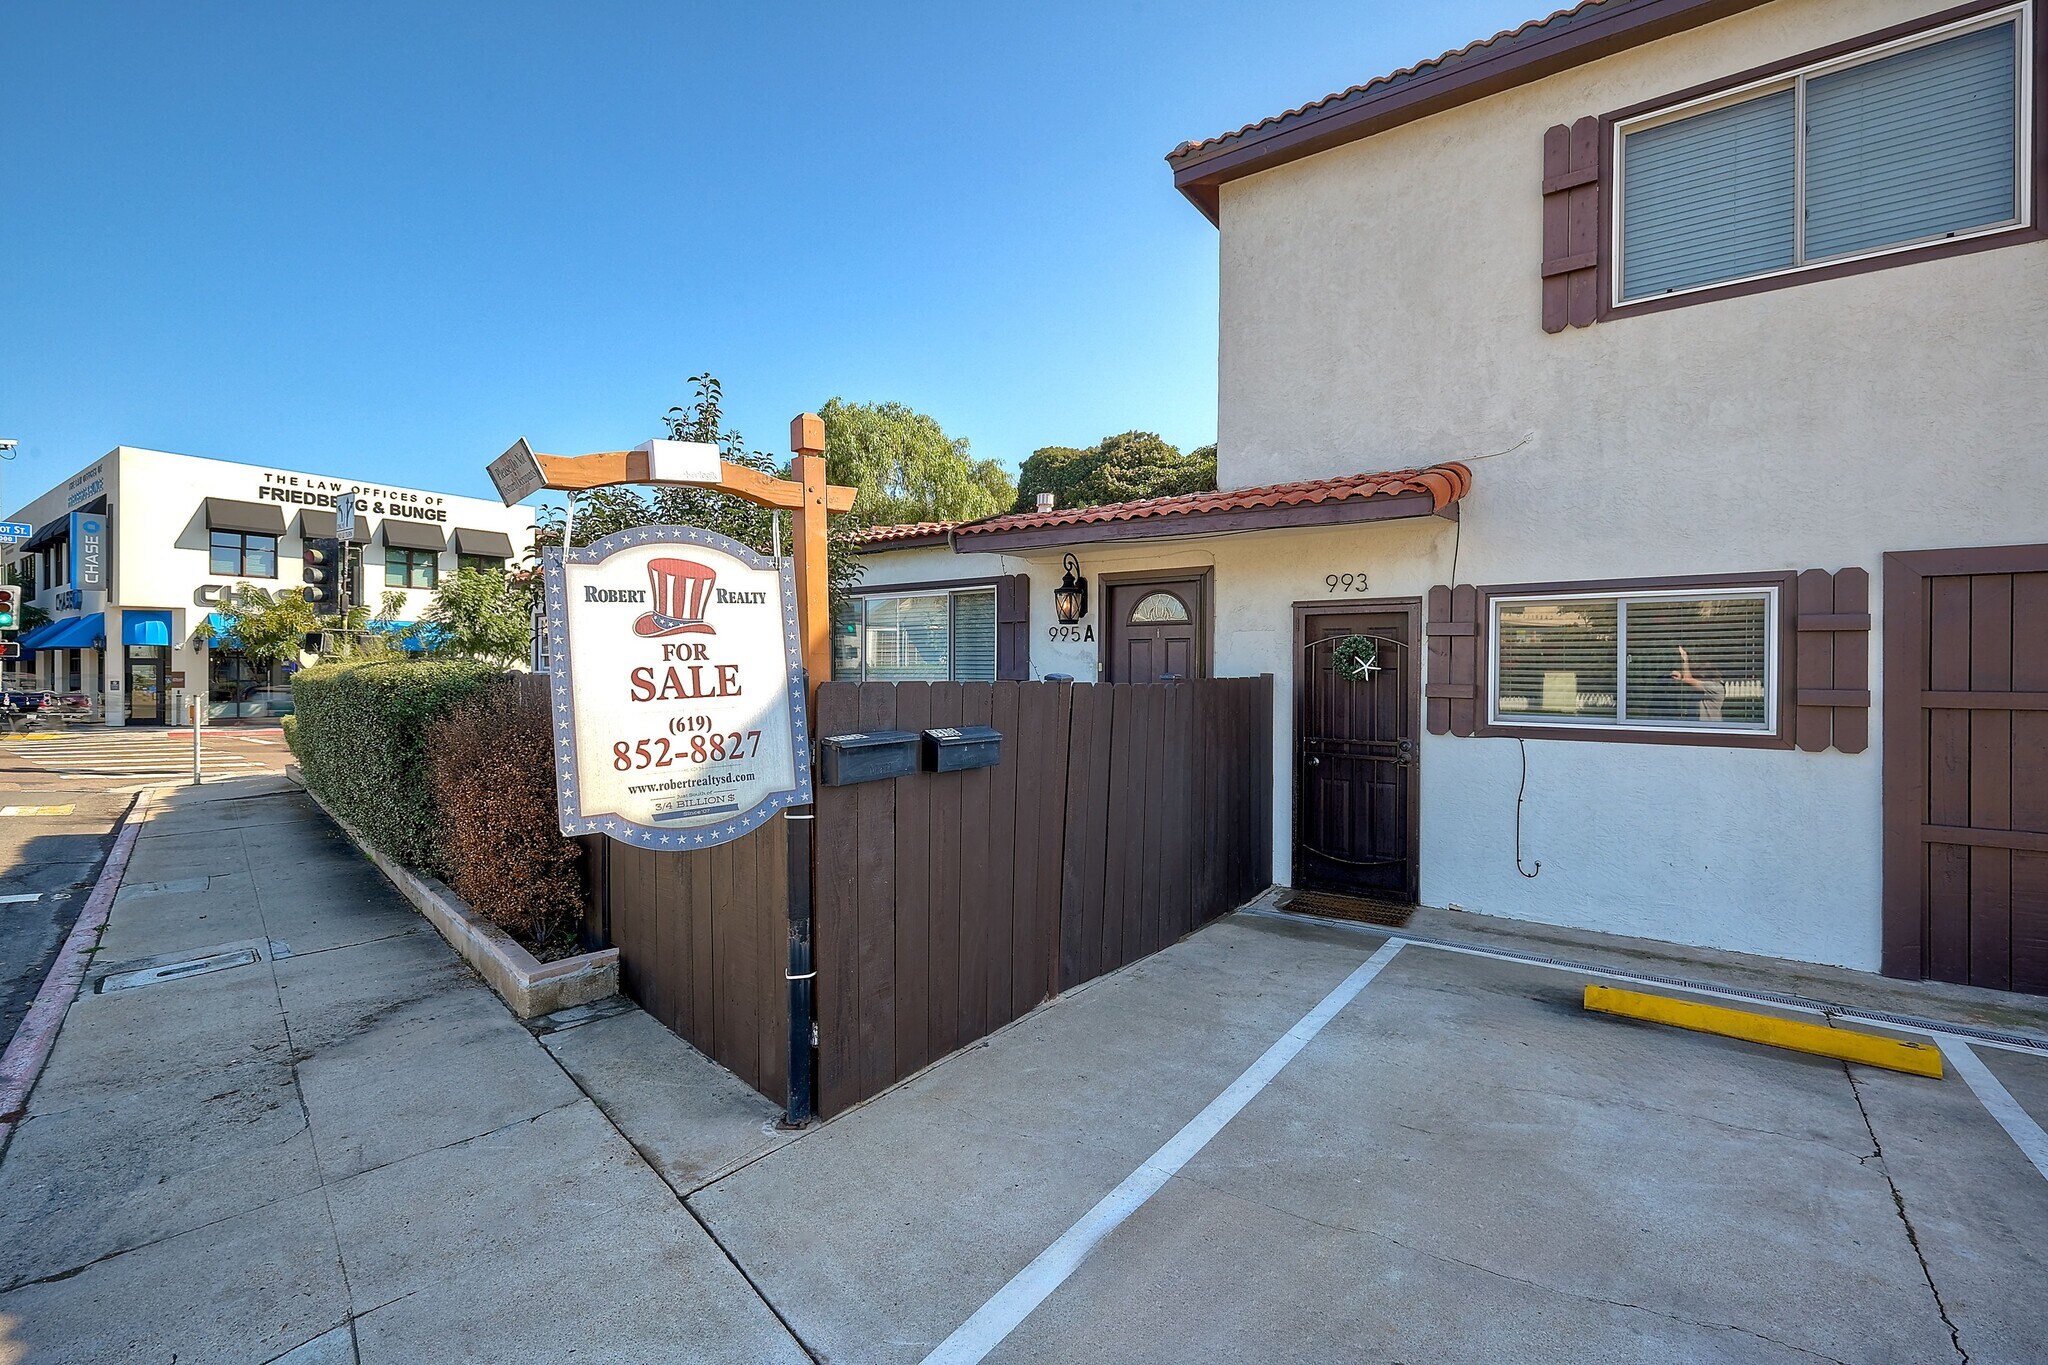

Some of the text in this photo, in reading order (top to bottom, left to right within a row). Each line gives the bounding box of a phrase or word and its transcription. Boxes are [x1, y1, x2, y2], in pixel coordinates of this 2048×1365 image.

[264, 473, 444, 506] THE LAW OFFICES OF
[258, 485, 447, 522] FRIEDBEG & BUNGE
[84, 535, 99, 584] CHASE
[584, 585, 766, 605] ROBERT REALTY
[1325, 572, 1369, 593] 993
[661, 643, 710, 662] FOR
[630, 664, 742, 703] SALE
[668, 714, 713, 735] (619)
[612, 730, 762, 772] 852-8827
[627, 771, 756, 796] www.robertrealtysd.com
[655, 793, 736, 812] 3/4 BILLION $
